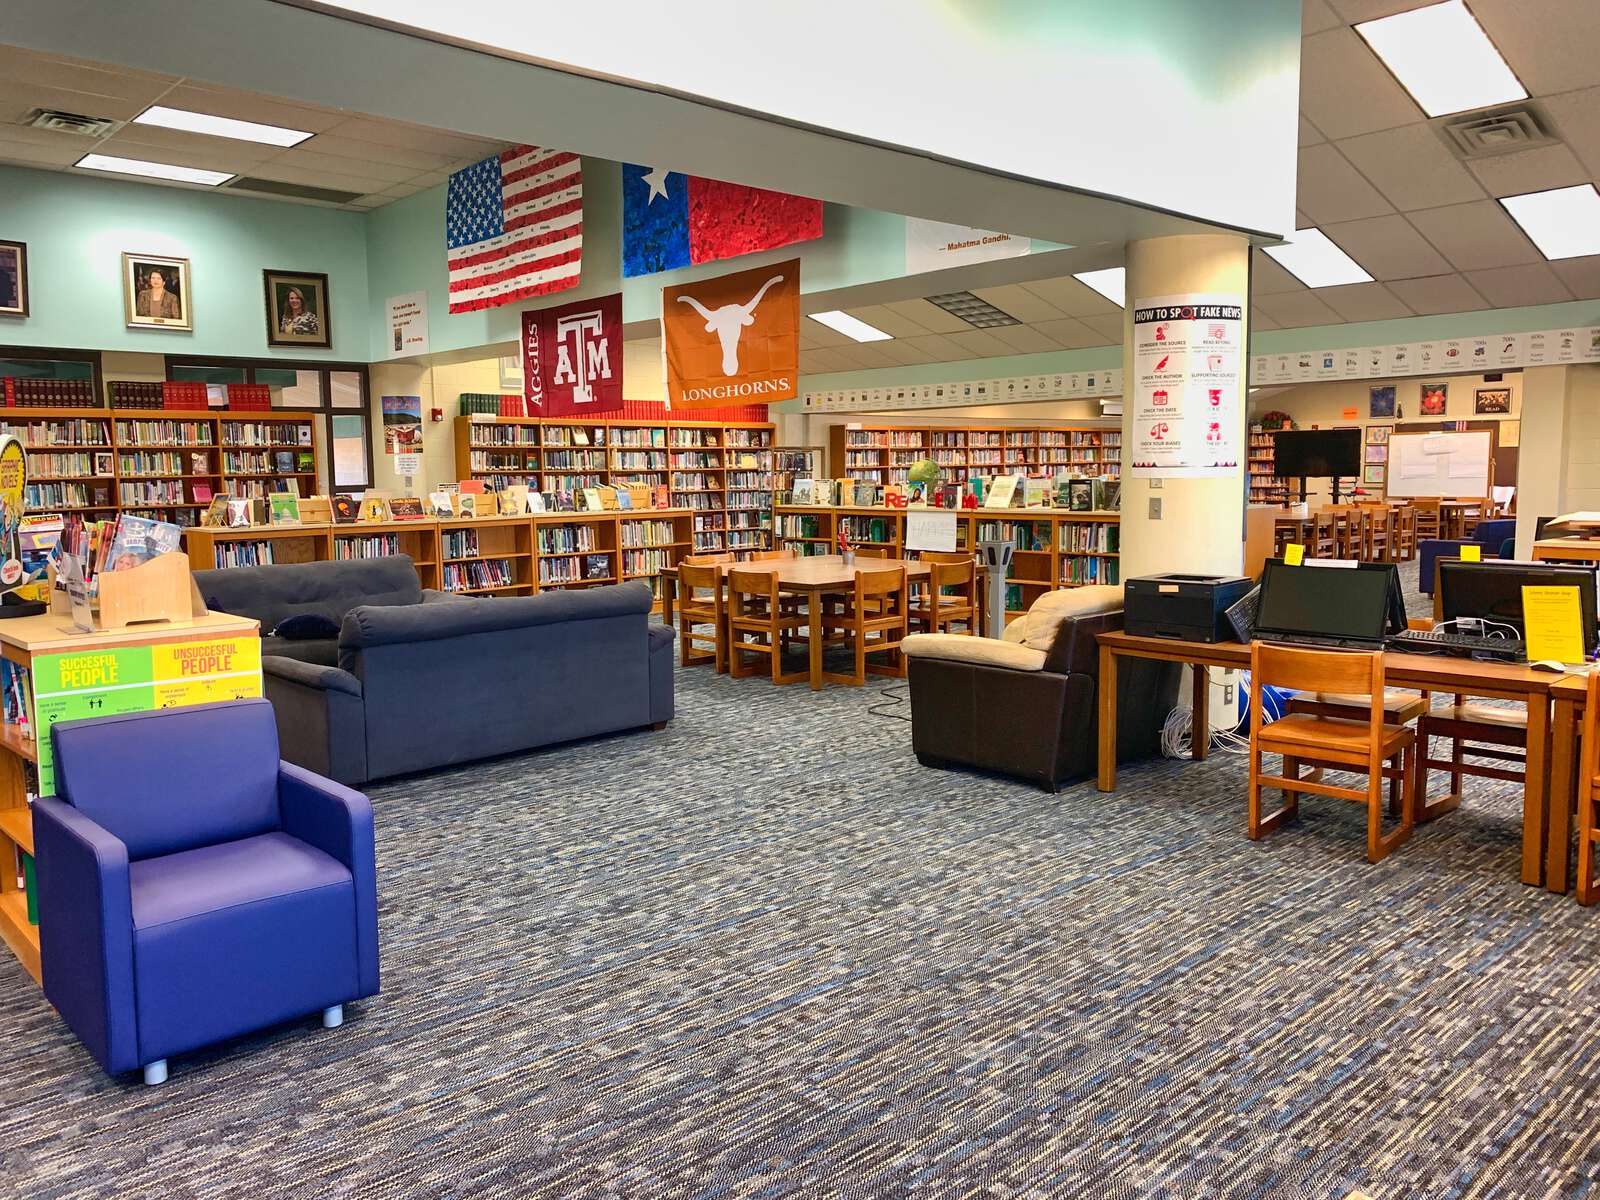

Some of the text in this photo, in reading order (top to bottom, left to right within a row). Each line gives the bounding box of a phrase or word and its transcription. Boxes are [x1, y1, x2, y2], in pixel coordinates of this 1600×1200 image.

[948, 240, 980, 250] Mahatma
[1136, 310, 1154, 321] HOW
[1157, 310, 1167, 319] TO
[1200, 307, 1220, 317] FAKE
[1222, 307, 1241, 318] NEWS
[528, 323, 543, 407] AGGIES
[682, 378, 790, 401] LONGHORNS
[173, 643, 238, 660] UNSUCCESFUL
[59, 654, 118, 671] SUCCESFUL
[181, 655, 232, 675] PEOPLE
[61, 666, 119, 688] PEOPLE
